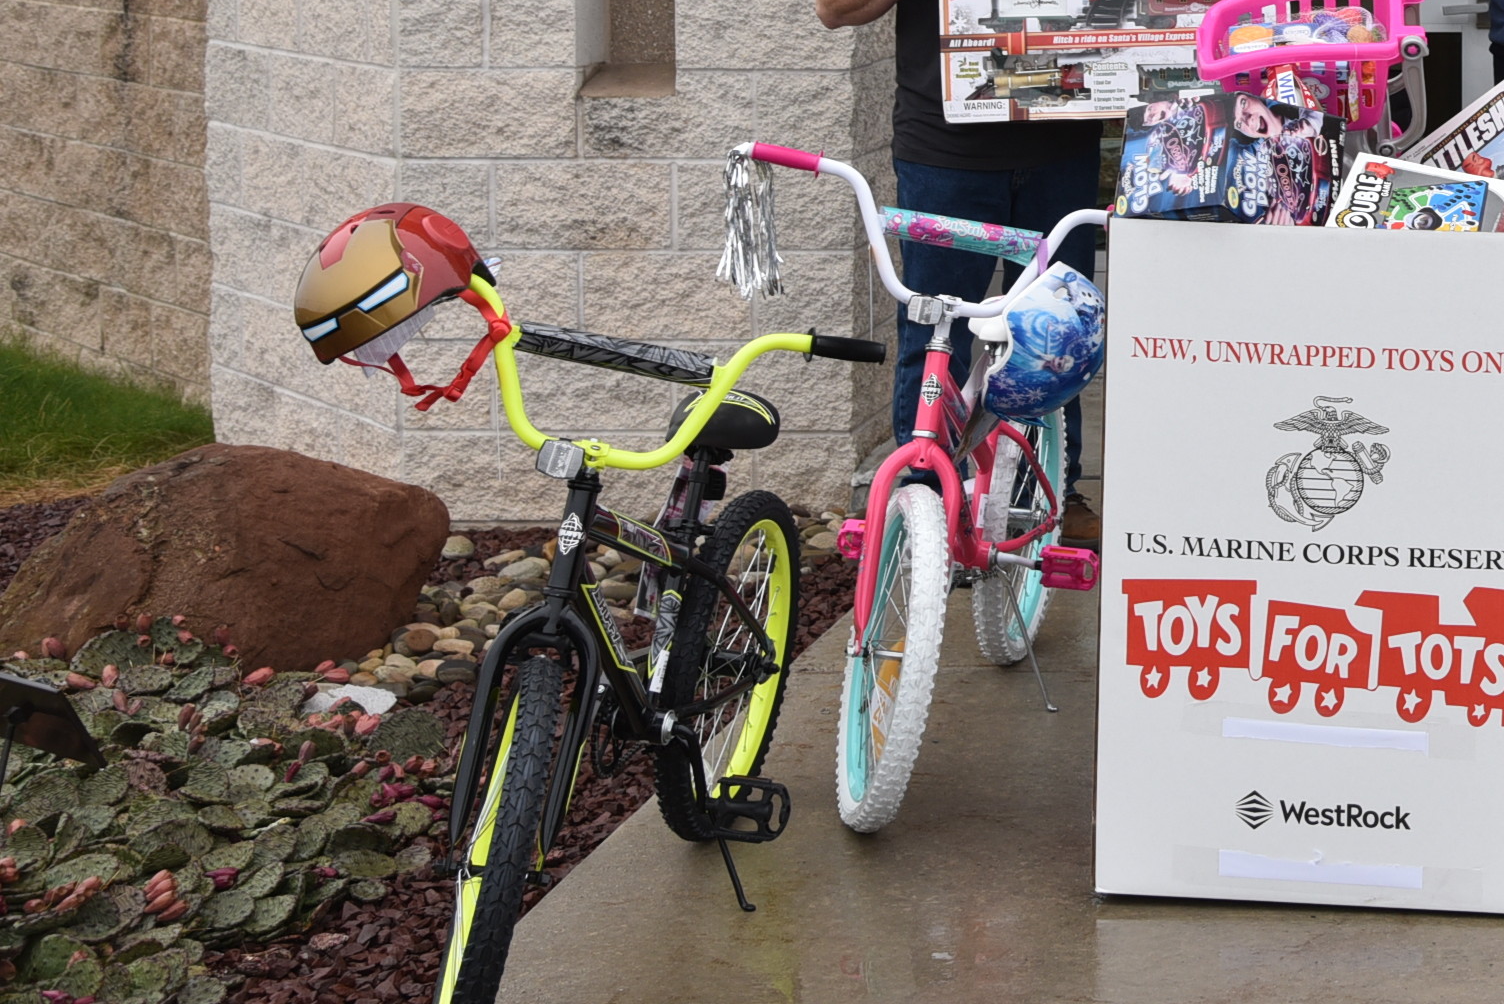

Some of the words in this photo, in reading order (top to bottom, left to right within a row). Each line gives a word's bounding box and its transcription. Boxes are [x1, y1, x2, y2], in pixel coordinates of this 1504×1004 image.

[949, 39, 961, 48] All
[962, 38, 995, 47] Aboard!
[1053, 36, 1073, 44] Hitch
[1081, 35, 1096, 43] ride
[1108, 34, 1137, 42] Santa's
[1138, 33, 1164, 43] Village
[1165, 32, 1194, 42] Express
[963, 101, 1006, 111] WARNING:
[1278, 74, 1297, 106] WIF
[1328, 138, 1340, 177] SPIN!
[1131, 153, 1149, 213] GLOW
[1148, 170, 1163, 196] DO
[1242, 149, 1257, 217] GLOW
[1256, 150, 1269, 207] DOME
[1381, 181, 1392, 197] GAME
[1342, 173, 1384, 228] OUBLE
[1130, 336, 1197, 365] NEW,
[1205, 340, 1376, 369] UNWRAPPED
[1382, 347, 1455, 373] TOYS
[1125, 532, 1173, 556] U.S.
[1180, 536, 1295, 563] MARINE
[1302, 542, 1400, 567] CORPS
[1133, 594, 1242, 657] TOYS
[1268, 614, 1358, 679] FOR
[1279, 799, 1411, 830] WestRock
